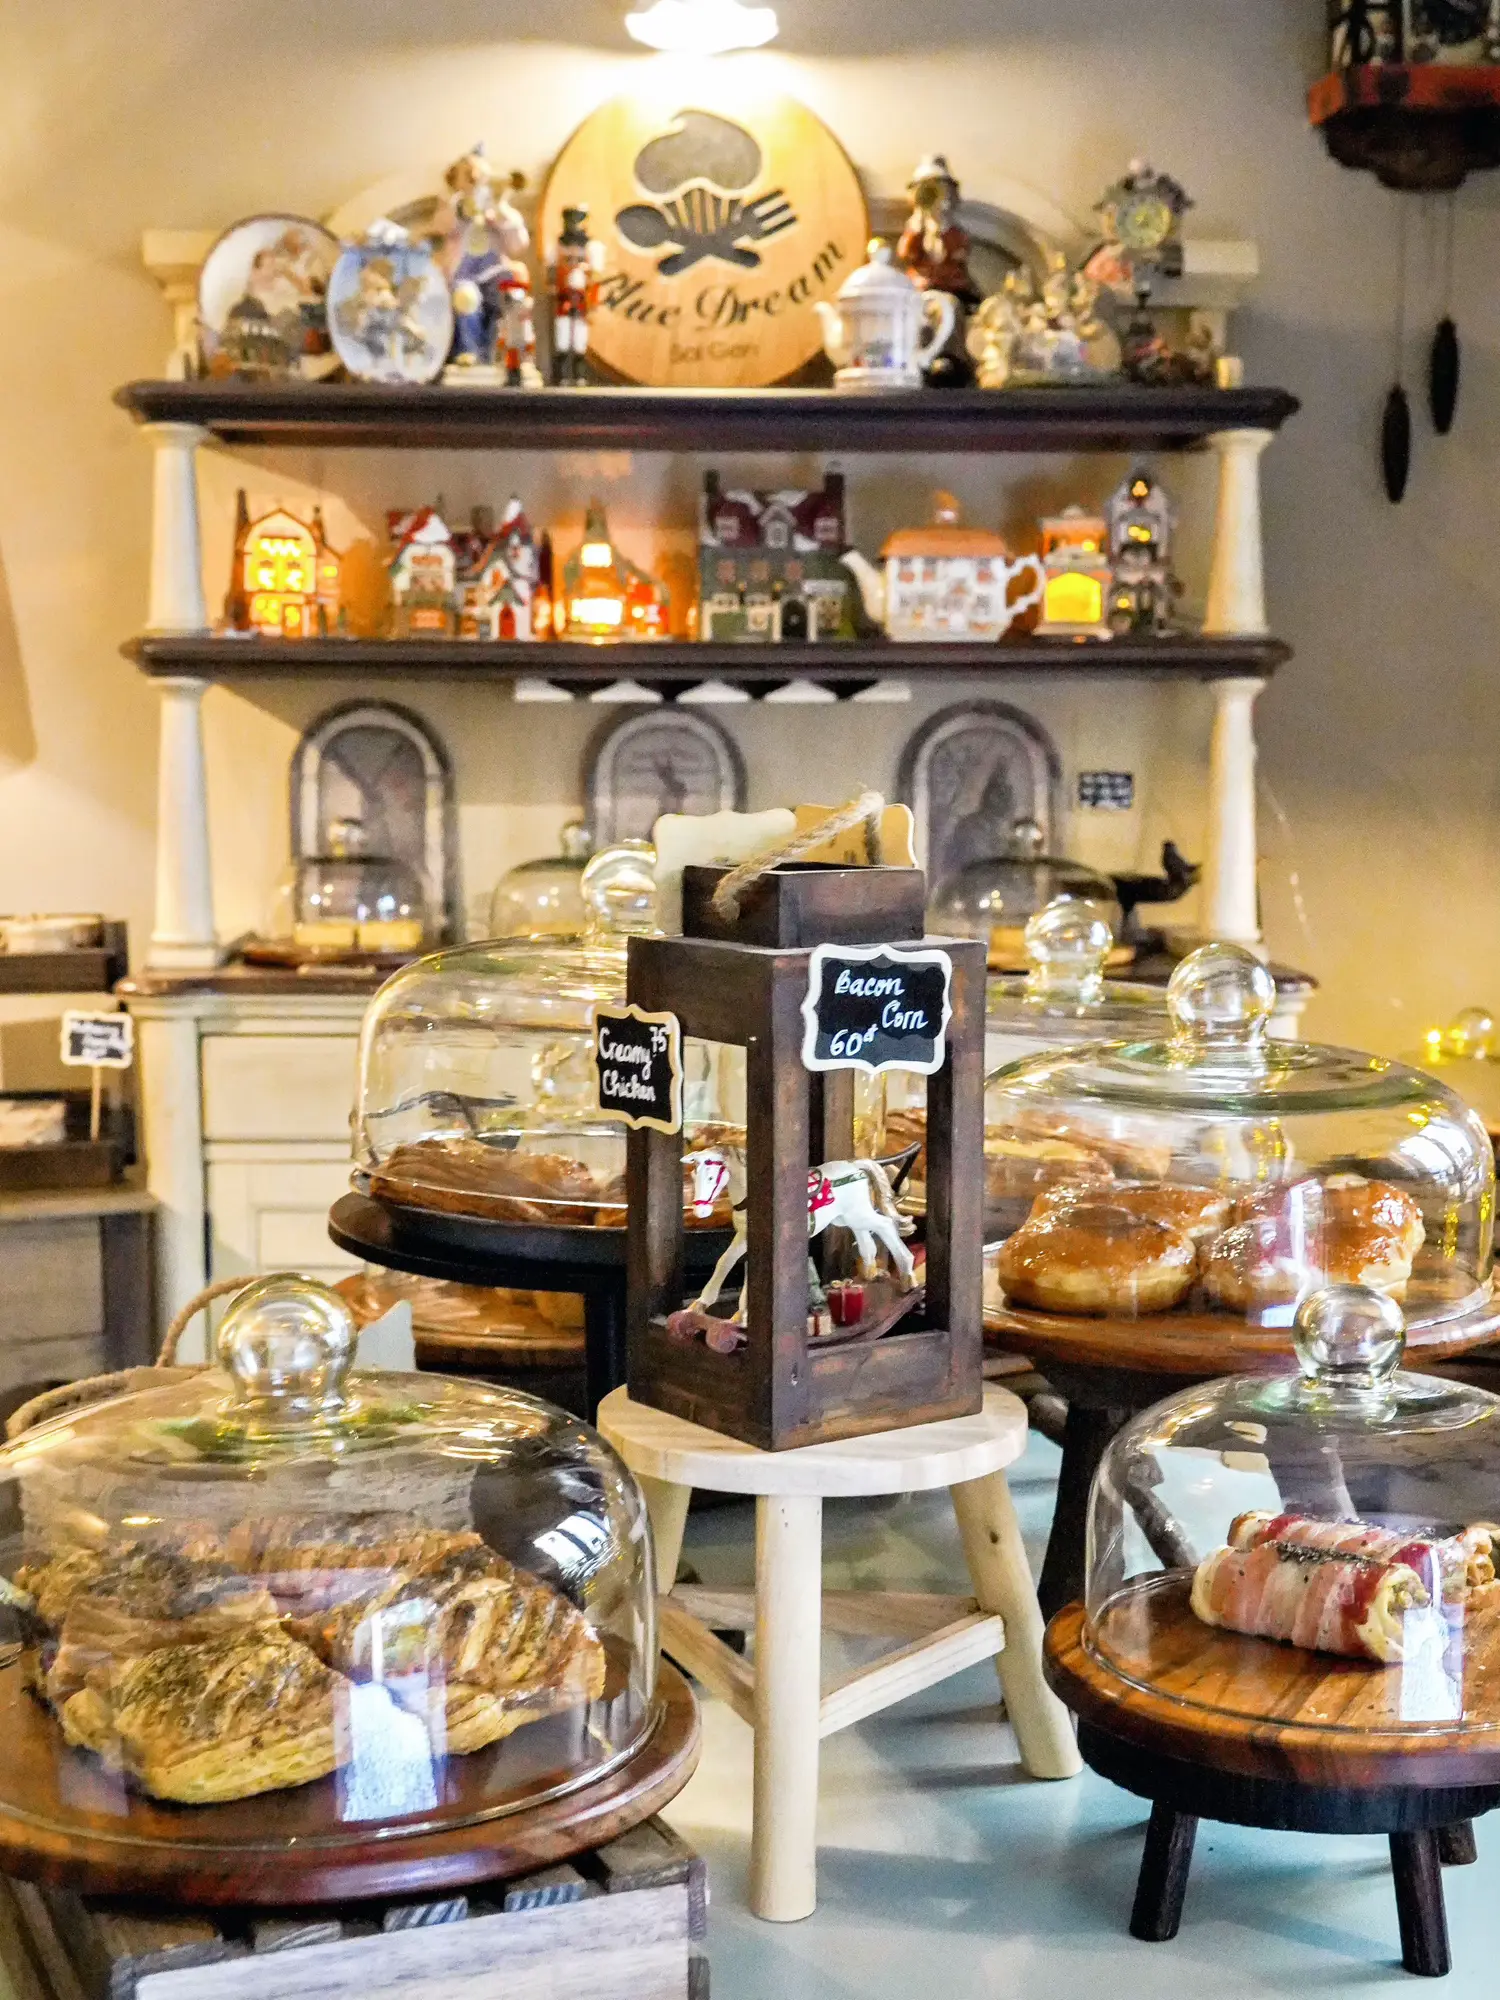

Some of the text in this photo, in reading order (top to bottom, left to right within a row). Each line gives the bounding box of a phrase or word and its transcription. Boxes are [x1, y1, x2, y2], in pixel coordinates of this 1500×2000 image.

[694, 240, 845, 330] Dream
[834, 969, 905, 997] Bacon
[881, 999, 929, 1030] Corn
[599, 1026, 653, 1081] Creamy
[602, 1069, 657, 1102] Chicken
